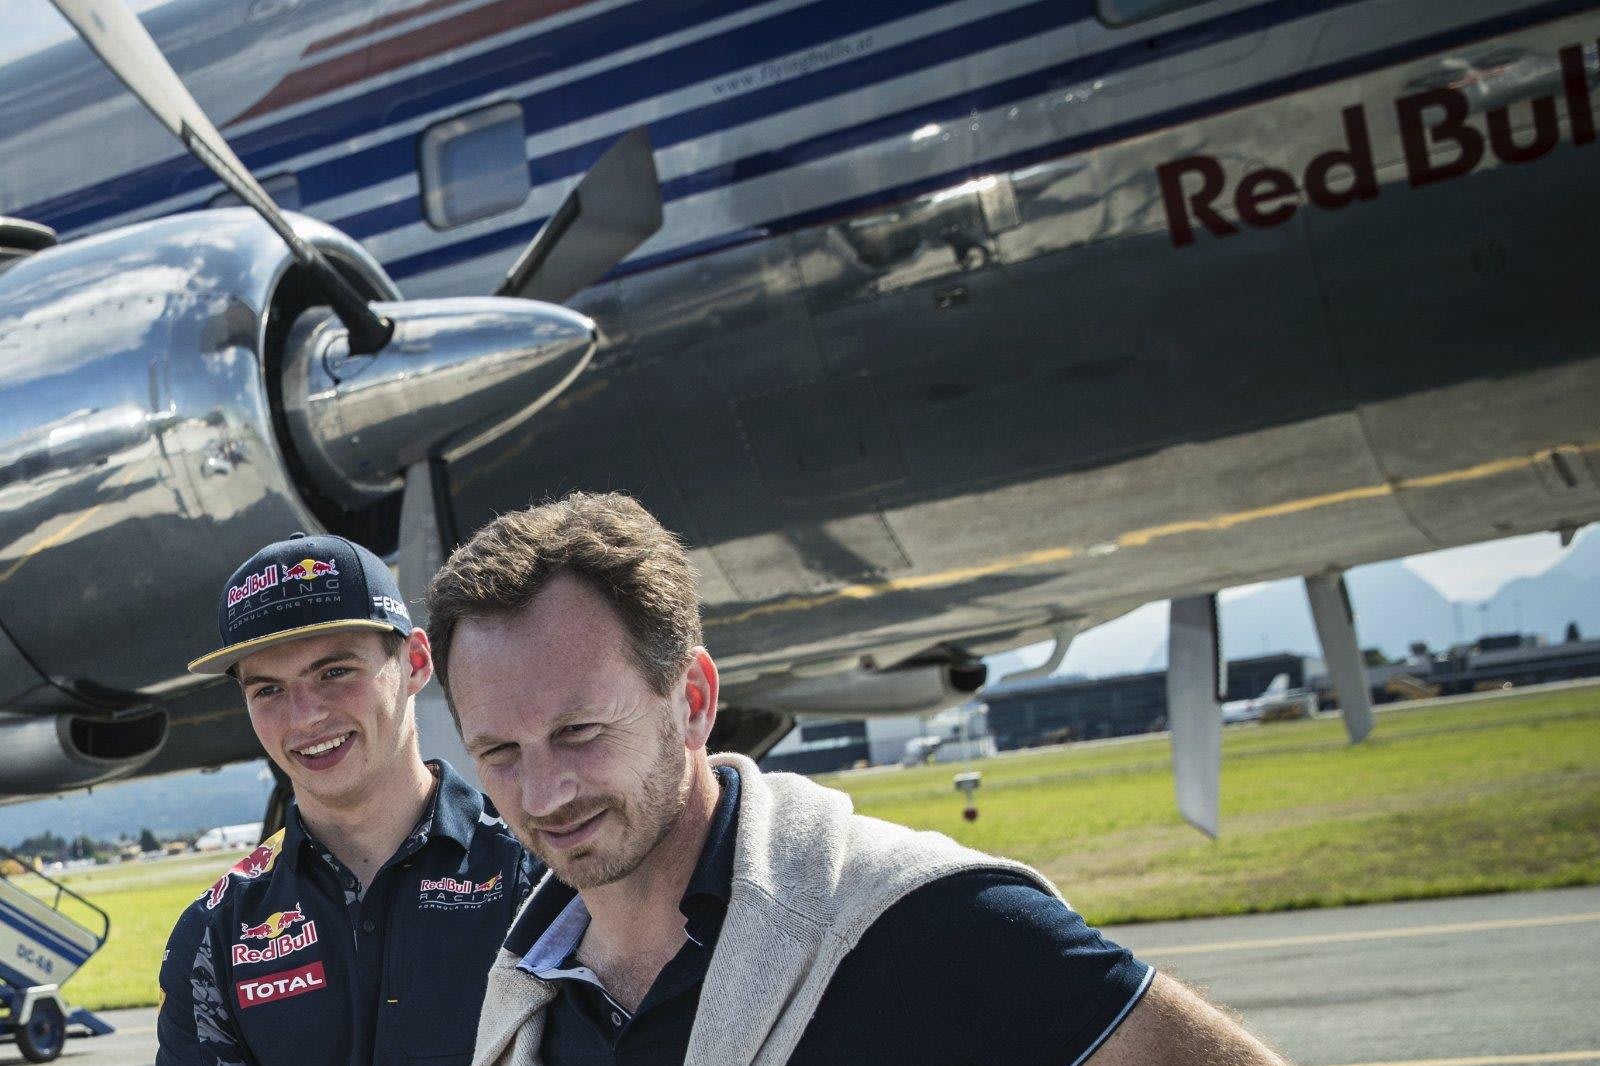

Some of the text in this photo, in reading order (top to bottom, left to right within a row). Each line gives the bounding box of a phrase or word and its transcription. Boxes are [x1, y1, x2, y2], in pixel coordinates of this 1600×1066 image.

[1155, 40, 1600, 249] Red Bul
[227, 564, 279, 608] Red Bull
[228, 579, 340, 620] RACING
[229, 596, 341, 632] FORMULA ONE TEAM
[420, 878, 472, 894] Red Bull
[232, 920, 318, 967] Red Bull
[240, 972, 323, 1001] TOTAL
